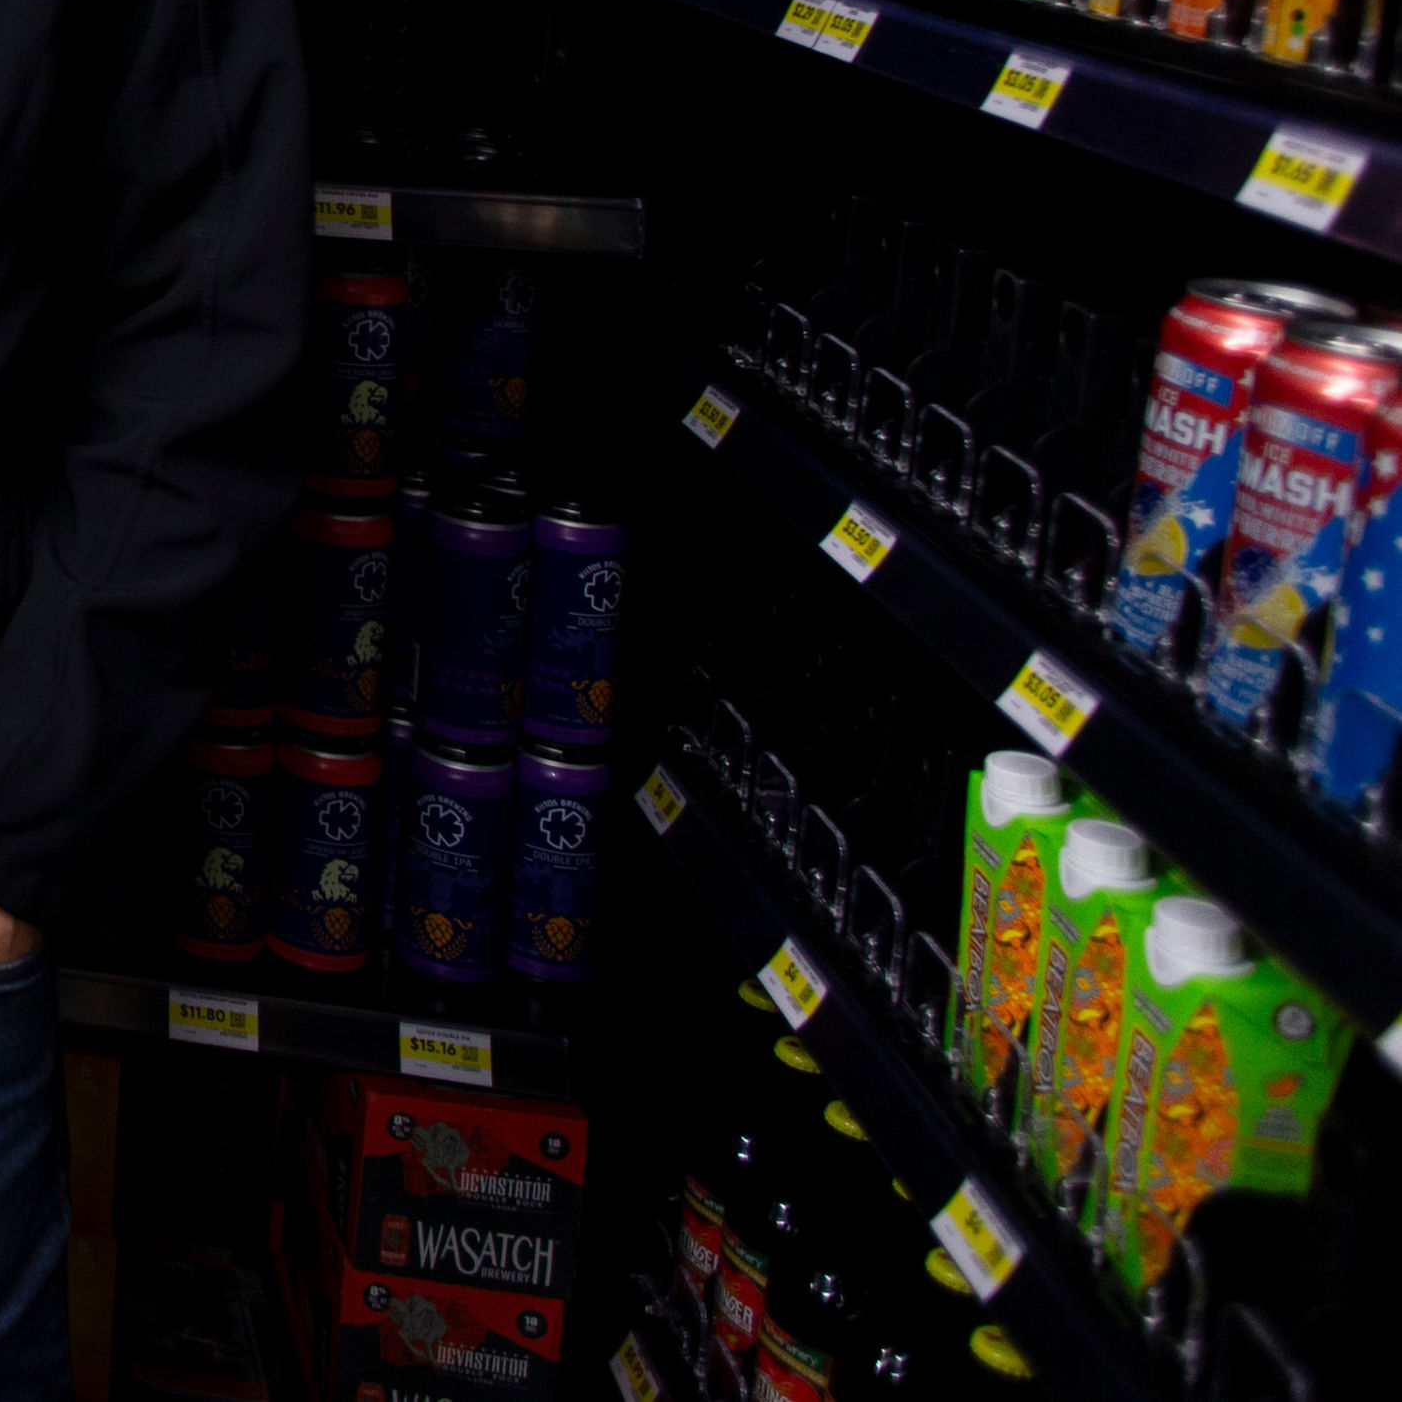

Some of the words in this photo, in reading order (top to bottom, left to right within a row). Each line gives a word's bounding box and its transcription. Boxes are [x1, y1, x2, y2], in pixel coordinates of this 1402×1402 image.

[841, 518, 868, 546] $3.50
[414, 846, 451, 864] DOUBLE
[453, 855, 474, 867] IPA
[534, 850, 572, 863] DOUBLE
[575, 854, 593, 866] IPA
[179, 1003, 225, 1023] $11.80
[409, 1037, 456, 1057] $15.16
[460, 1171, 551, 1203] DEVASTATOR
[416, 1219, 554, 1288] WASATCH
[480, 1266, 531, 1284] BREWERY
[437, 1344, 529, 1379] DEVASTATOR
